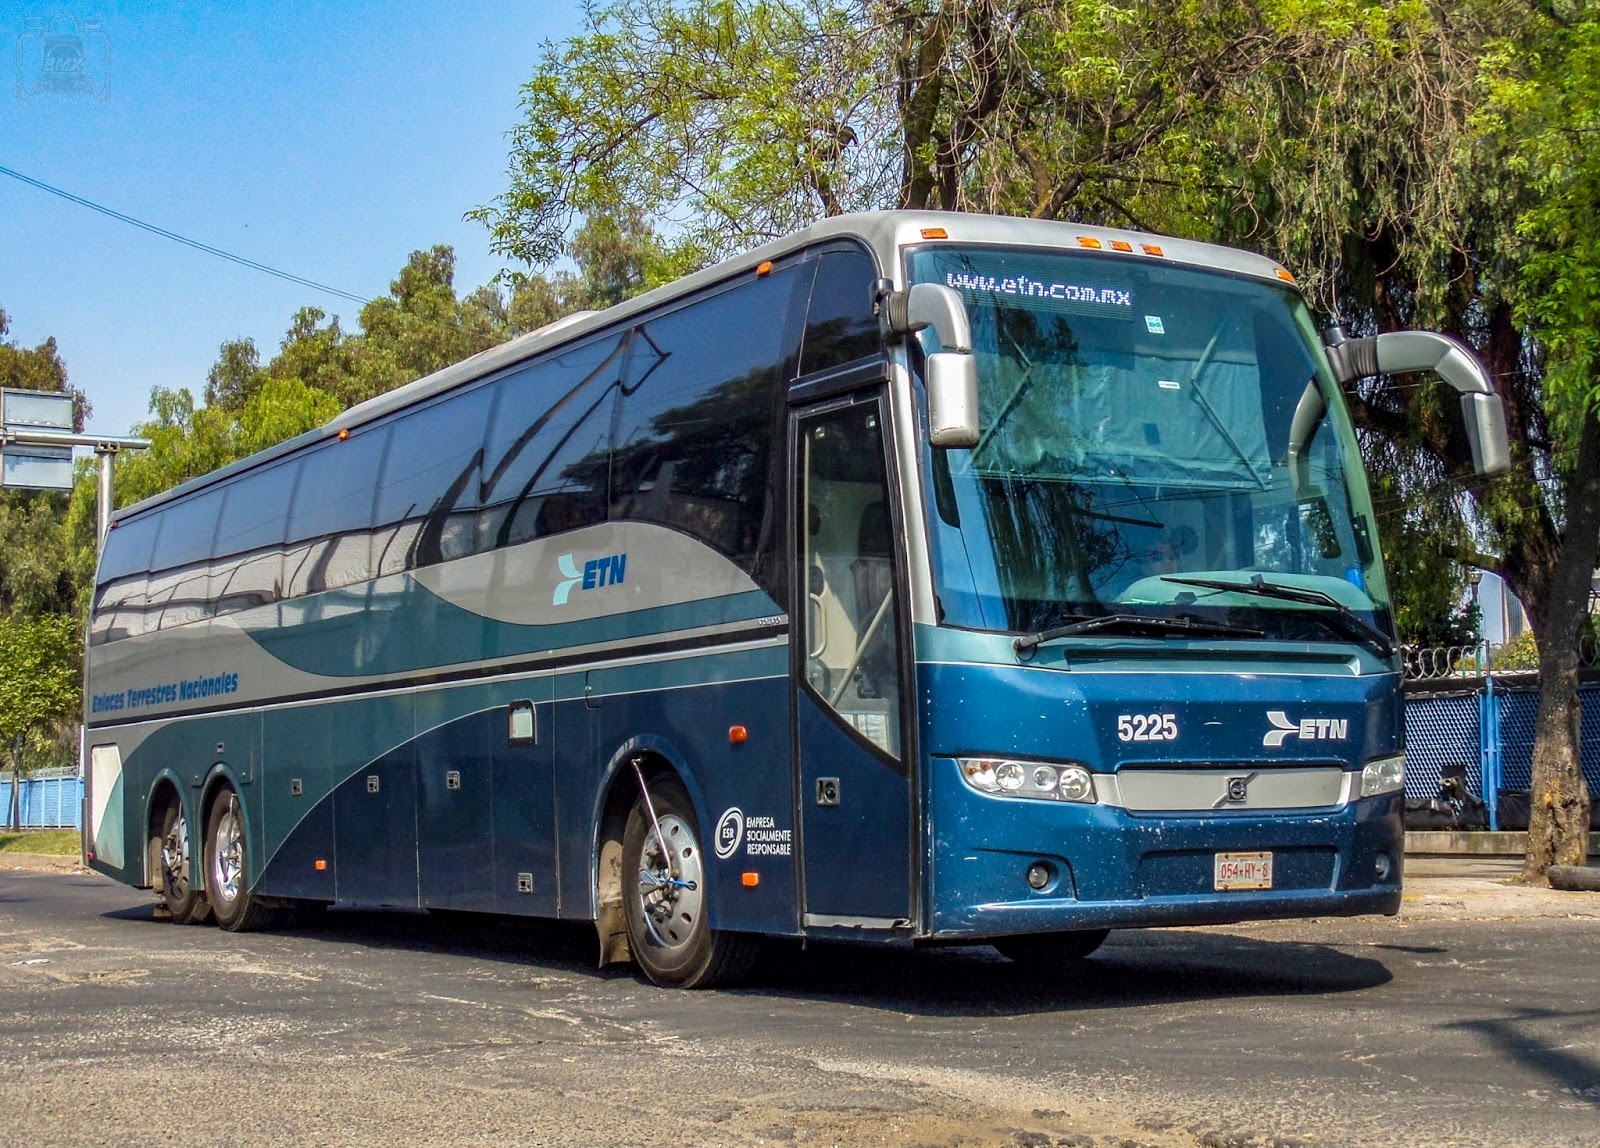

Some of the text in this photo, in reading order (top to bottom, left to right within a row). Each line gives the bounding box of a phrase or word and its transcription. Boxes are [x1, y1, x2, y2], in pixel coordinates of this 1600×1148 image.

[947, 273, 1131, 305] www.etn.com.mx
[582, 554, 627, 590] ETN
[92, 672, 239, 713] Enlaces Terrestres Nacionales
[1118, 714, 1178, 741] 5225
[1299, 719, 1348, 739] ETN
[746, 817, 775, 828] EMPRESA
[722, 828, 734, 838] ESR
[746, 830, 792, 841] SOCIALMENTE
[746, 843, 791, 855] RESPONSABLE
